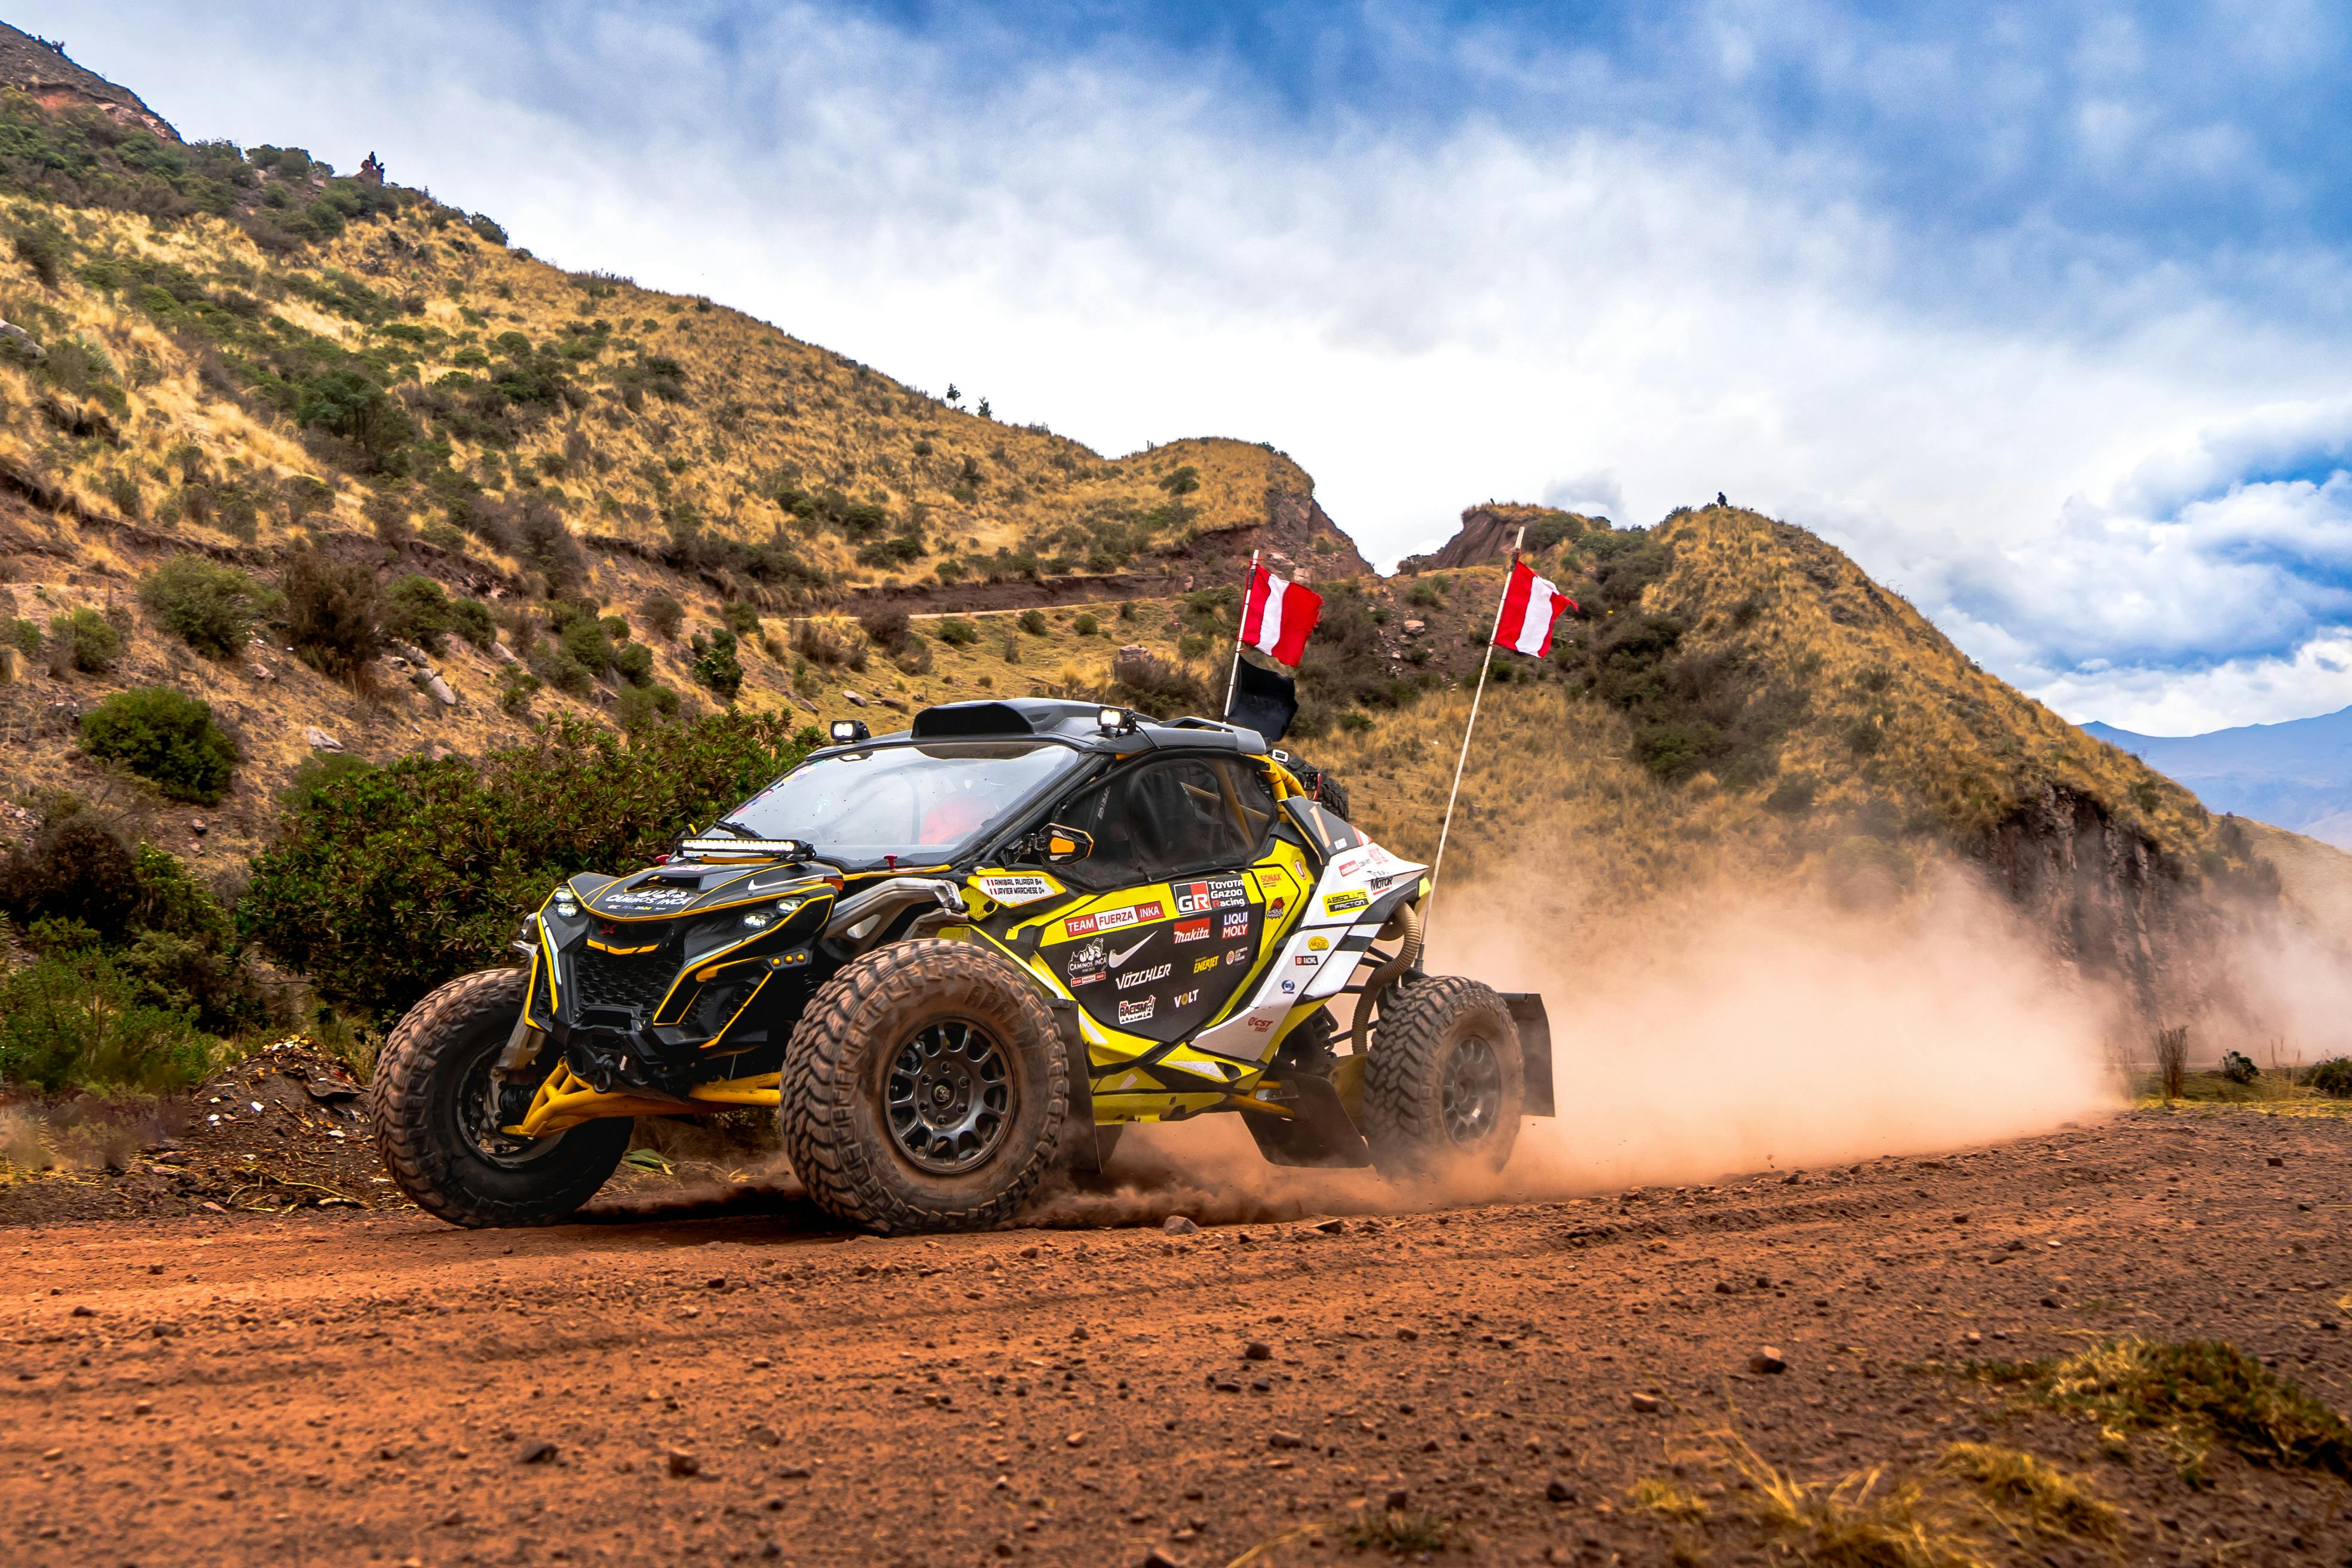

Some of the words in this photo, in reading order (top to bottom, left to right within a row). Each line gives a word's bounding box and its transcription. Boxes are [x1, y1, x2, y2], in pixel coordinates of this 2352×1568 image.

[1208, 879, 1244, 890] TOYOTA
[1260, 874, 1281, 883] SONAX
[605, 895, 657, 904] CAMINOS
[657, 897, 693, 905] INCA
[1211, 889, 1243, 899] GAZOO
[1327, 892, 1367, 904] ABSOLUTE
[1178, 893, 1209, 912] GR
[1211, 898, 1245, 907] Racing
[1334, 899, 1365, 909] FRICTION
[1067, 918, 1094, 932] TEAM
[1099, 911, 1134, 926] FUERZA
[1140, 905, 1160, 918] INKA
[1224, 912, 1248, 925] LIQUI
[1222, 924, 1248, 938] MOLY
[1070, 961, 1093, 970] CAMINOS
[1095, 957, 1107, 966] INCA
[1193, 956, 1219, 973] ENERJET
[1115, 963, 1171, 990] VÖZCHLER
[1174, 989, 1199, 1008] VOLT
